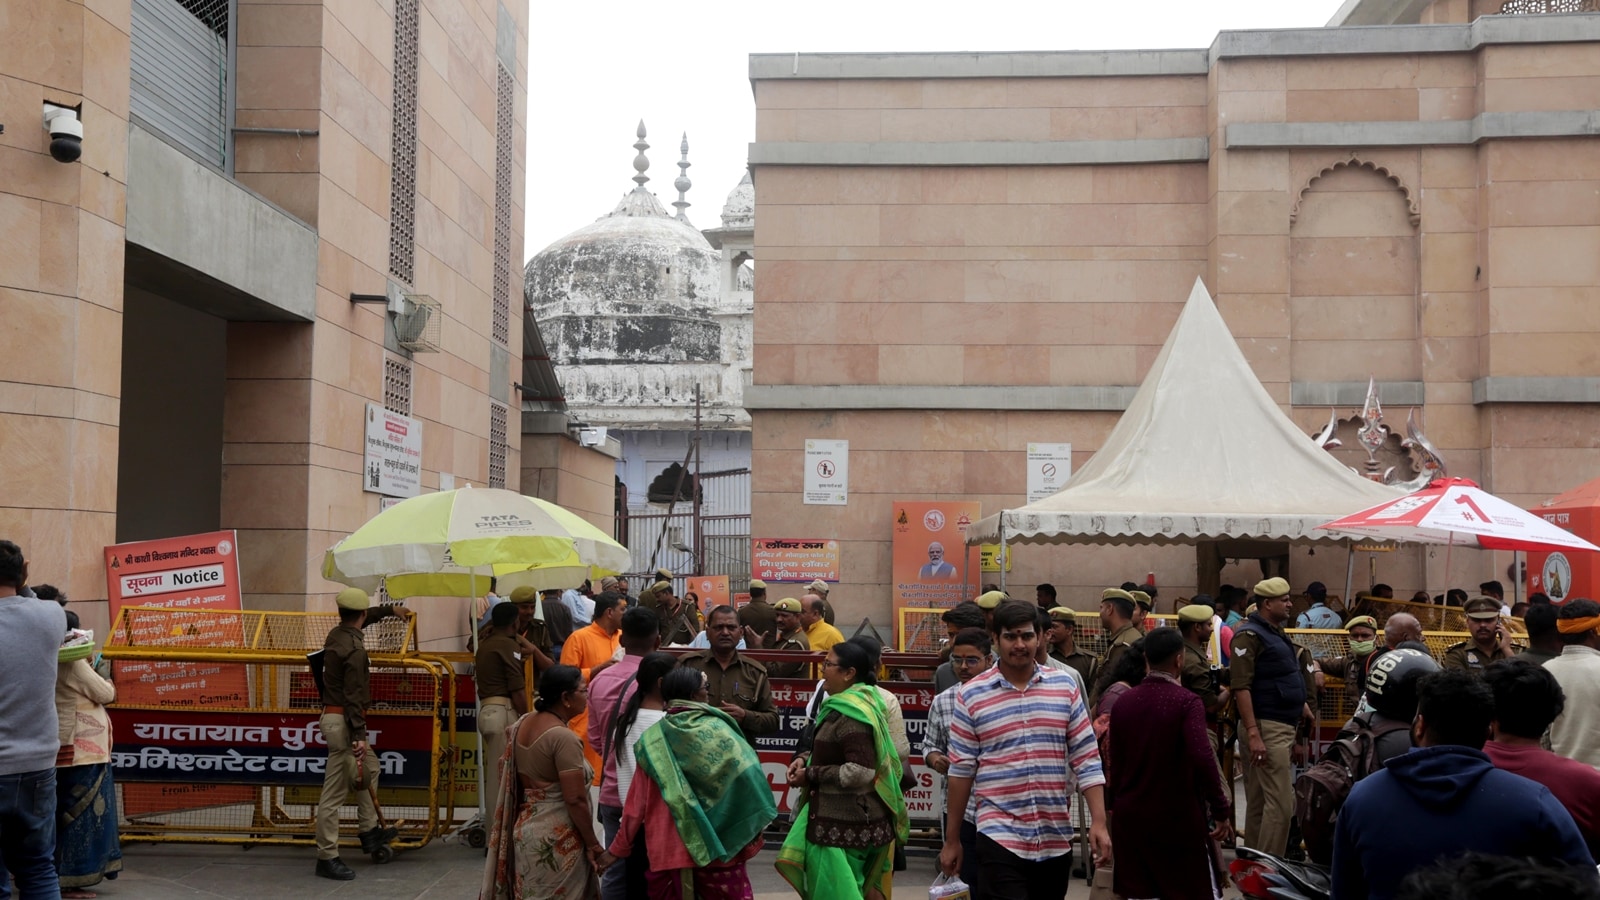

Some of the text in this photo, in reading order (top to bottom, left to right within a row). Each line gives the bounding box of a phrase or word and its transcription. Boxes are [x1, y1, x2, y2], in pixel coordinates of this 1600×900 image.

[474, 520, 533, 529] PIPES
[765, 540, 824, 550] लॉकर रूम
[124, 554, 134, 565] श्री
[134, 552, 151, 564] काशी
[152, 550, 179, 562] विश्वनाथ
[200, 546, 216, 556] न्यास
[801, 560, 831, 568] लॉकर
[172, 570, 219, 586] Notice
[761, 569, 773, 578] की
[126, 575, 163, 594] सूचना
[1366, 653, 1404, 695] 1901
[133, 723, 274, 743] यातायात
[110, 747, 408, 775] कमिश्नरेट वारसी
